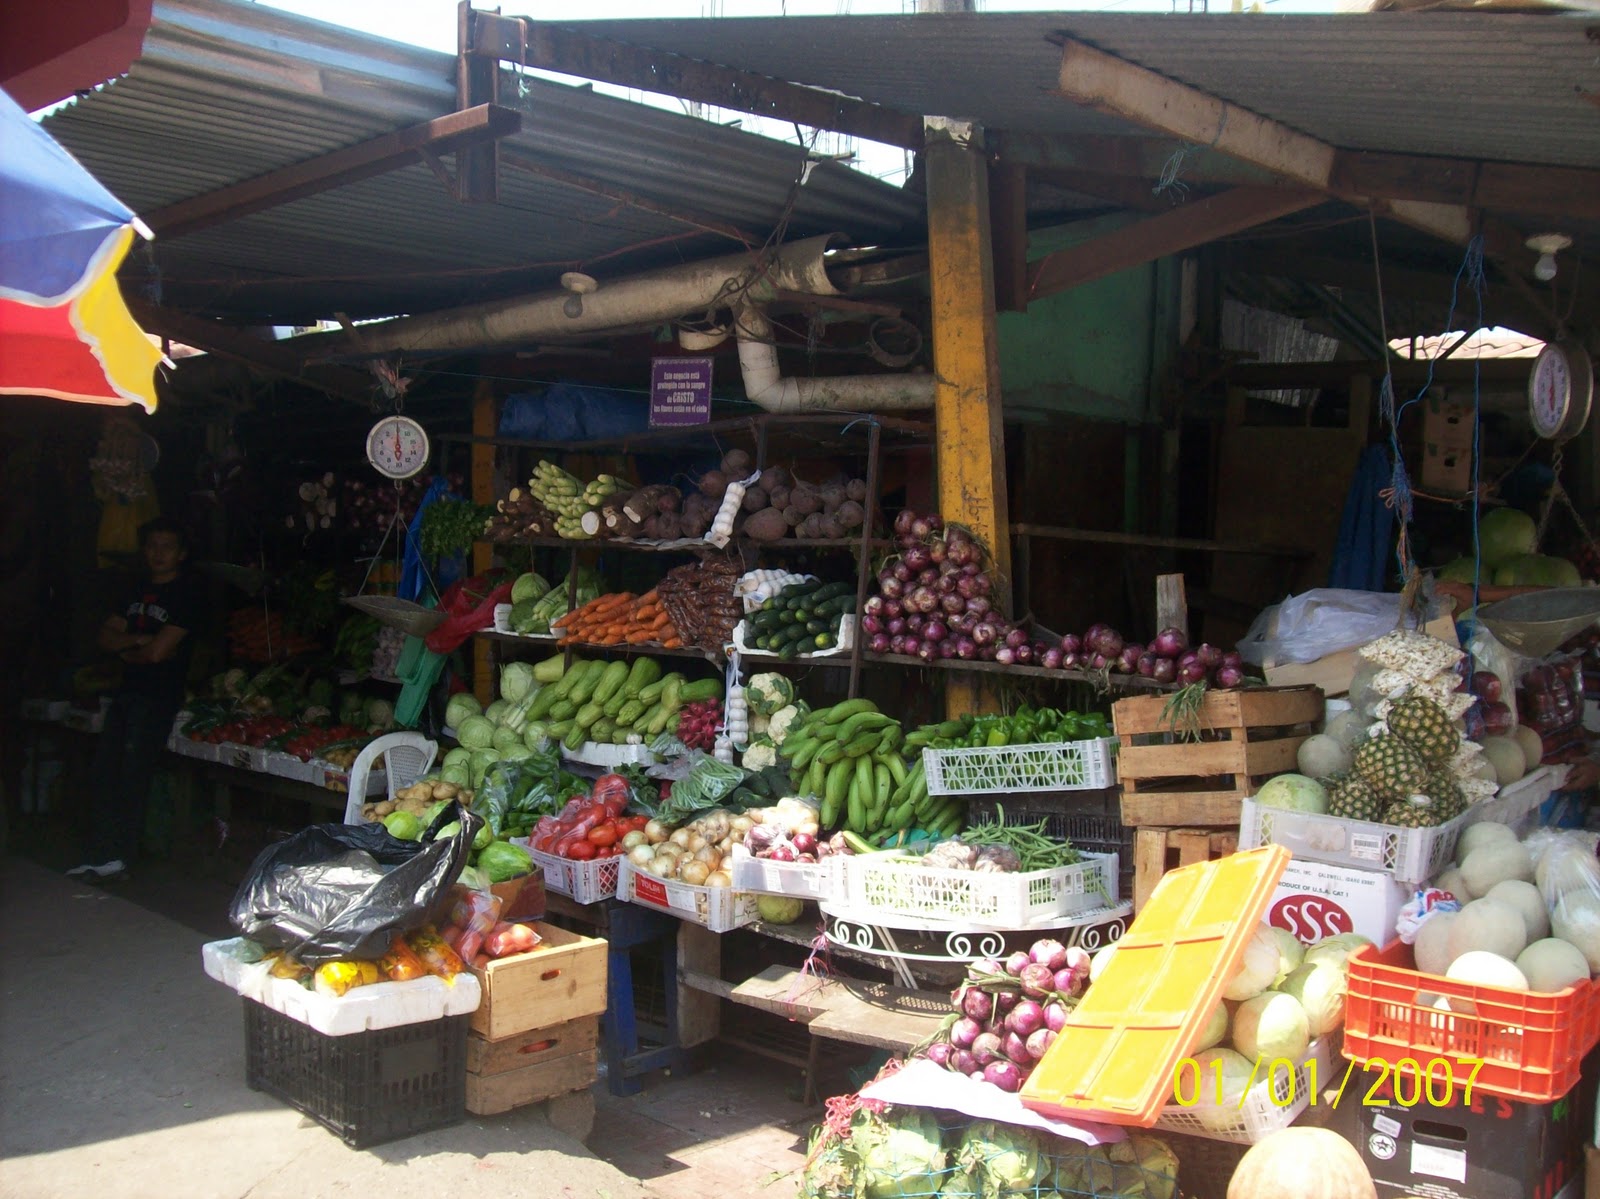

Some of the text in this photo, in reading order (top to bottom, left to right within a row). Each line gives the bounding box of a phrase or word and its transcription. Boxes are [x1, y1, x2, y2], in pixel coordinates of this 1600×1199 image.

[657, 382, 677, 390] protegido
[691, 382, 705, 390] sangre
[673, 392, 694, 403] CRISTO
[1277, 881, 1301, 889] RODUCE
[1312, 887, 1331, 895] U.S.A.
[1282, 901, 1342, 944] SSS
